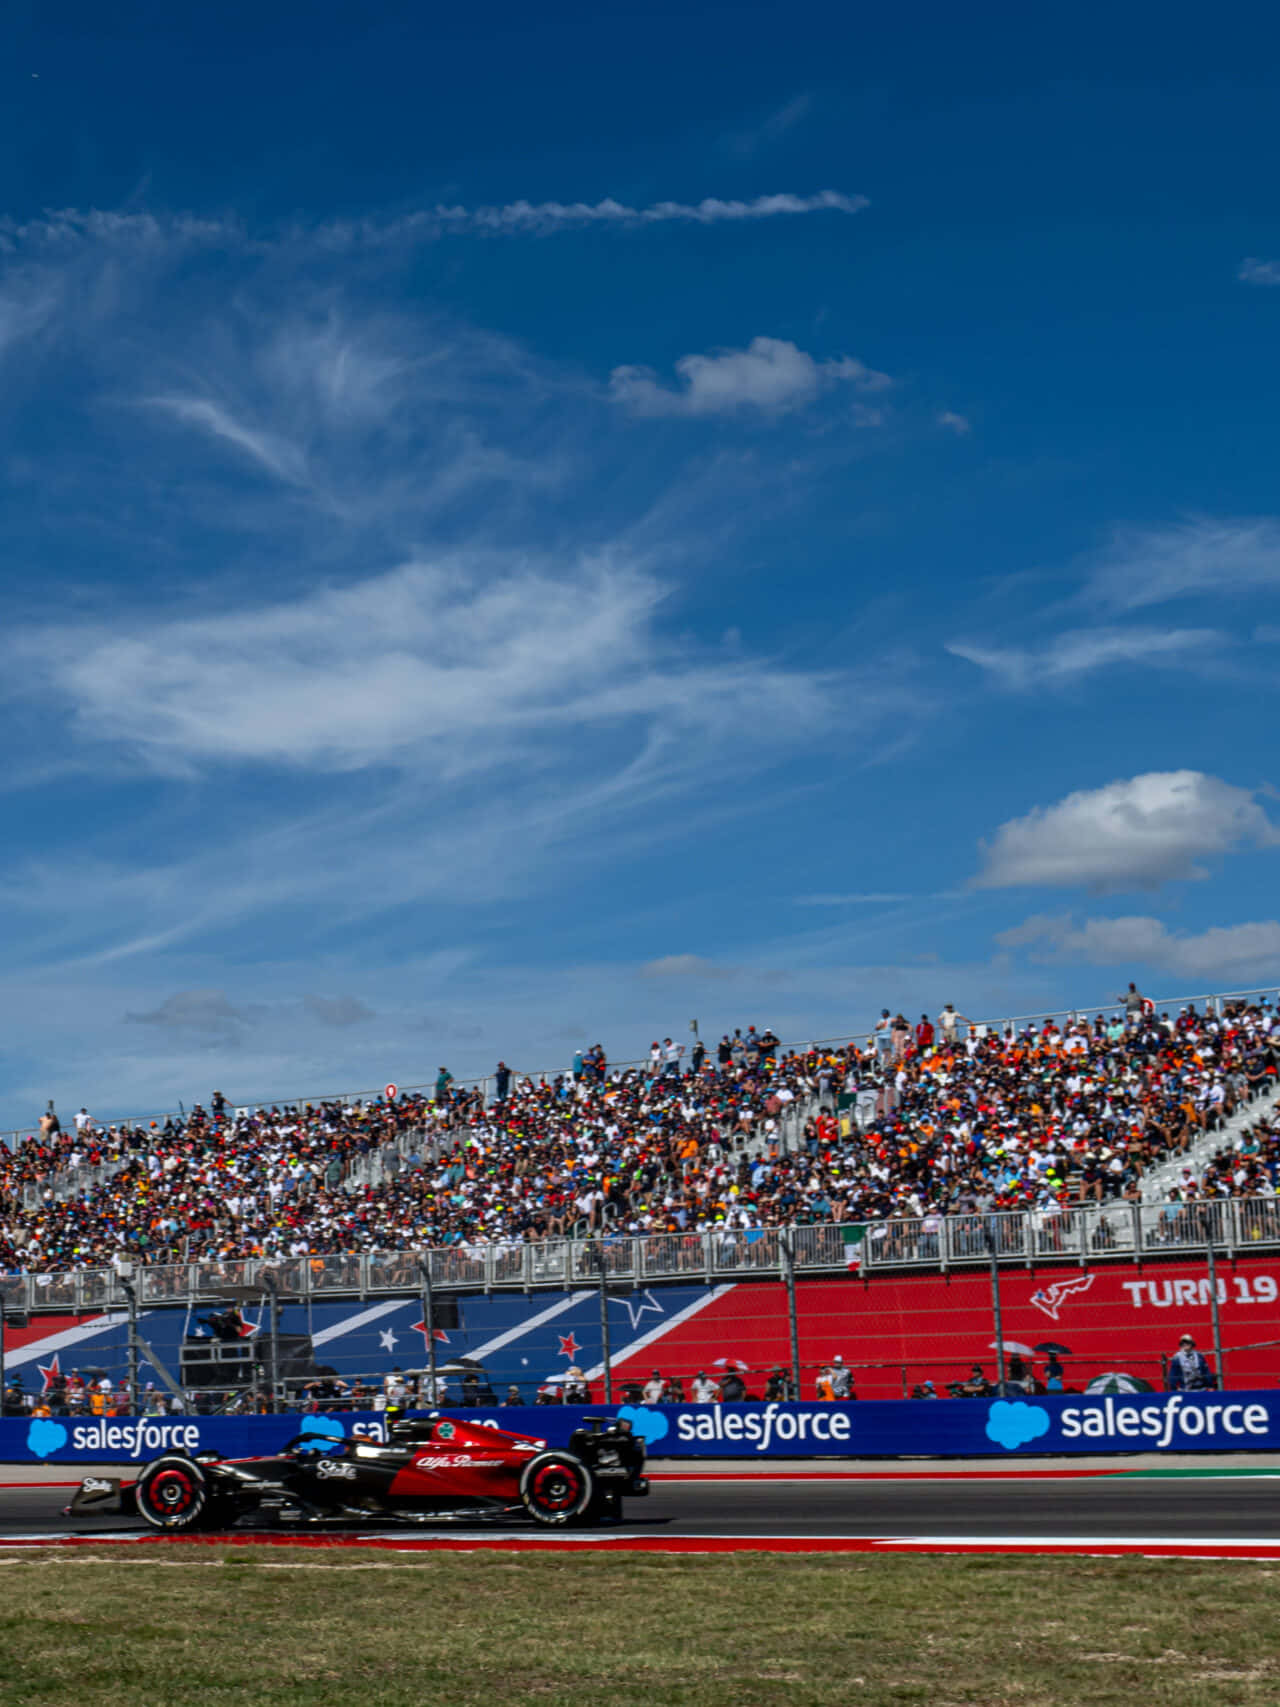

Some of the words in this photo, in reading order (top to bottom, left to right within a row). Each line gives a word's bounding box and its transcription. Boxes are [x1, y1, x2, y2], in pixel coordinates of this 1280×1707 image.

[1122, 1278, 1227, 1308] TURN
[1233, 1276, 1278, 1304] 19
[73, 1418, 200, 1457] salesforce
[677, 1403, 851, 1450] salesforce
[1061, 1395, 1269, 1448] salesforce
